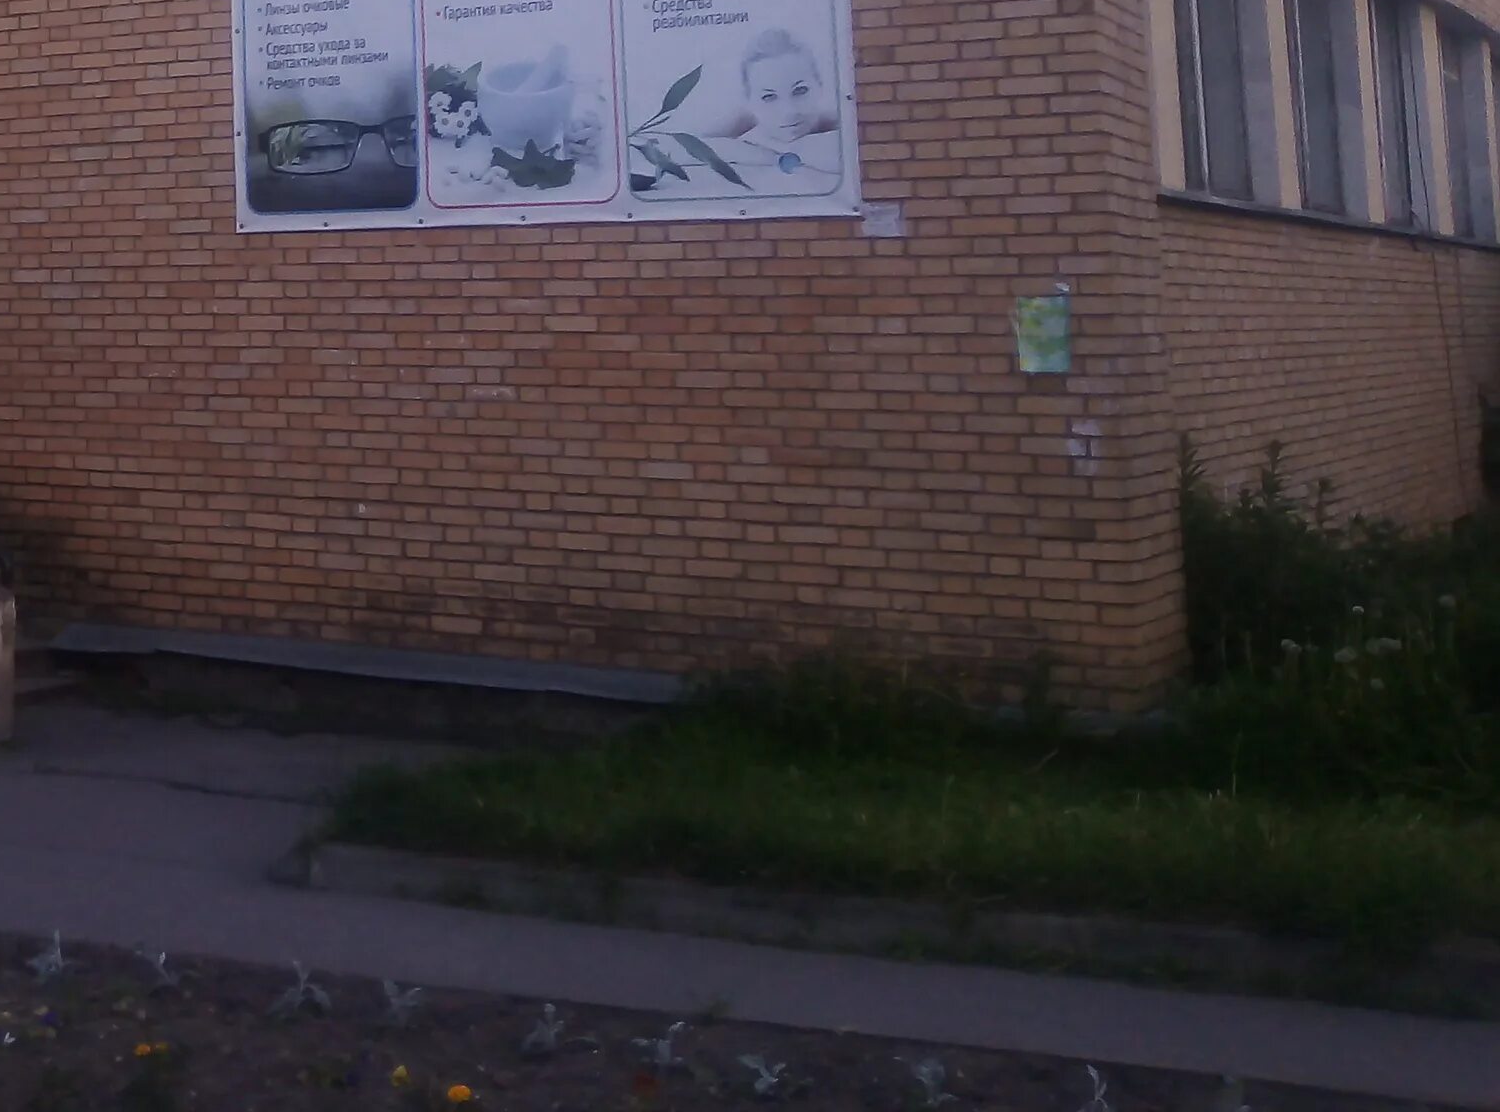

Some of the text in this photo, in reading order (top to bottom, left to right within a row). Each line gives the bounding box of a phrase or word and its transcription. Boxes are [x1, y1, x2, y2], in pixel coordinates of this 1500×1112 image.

[264, 2, 300, 17] Линзы
[442, 0, 554, 22] Гарантия качества
[265, 20, 329, 37] Аксессуары
[652, 10, 749, 33] реабилитации
[266, 41, 316, 58] Средства
[318, 39, 351, 55] ухода
[266, 51, 389, 71] контактными линзами
[267, 75, 341, 90] Ремонт очков
